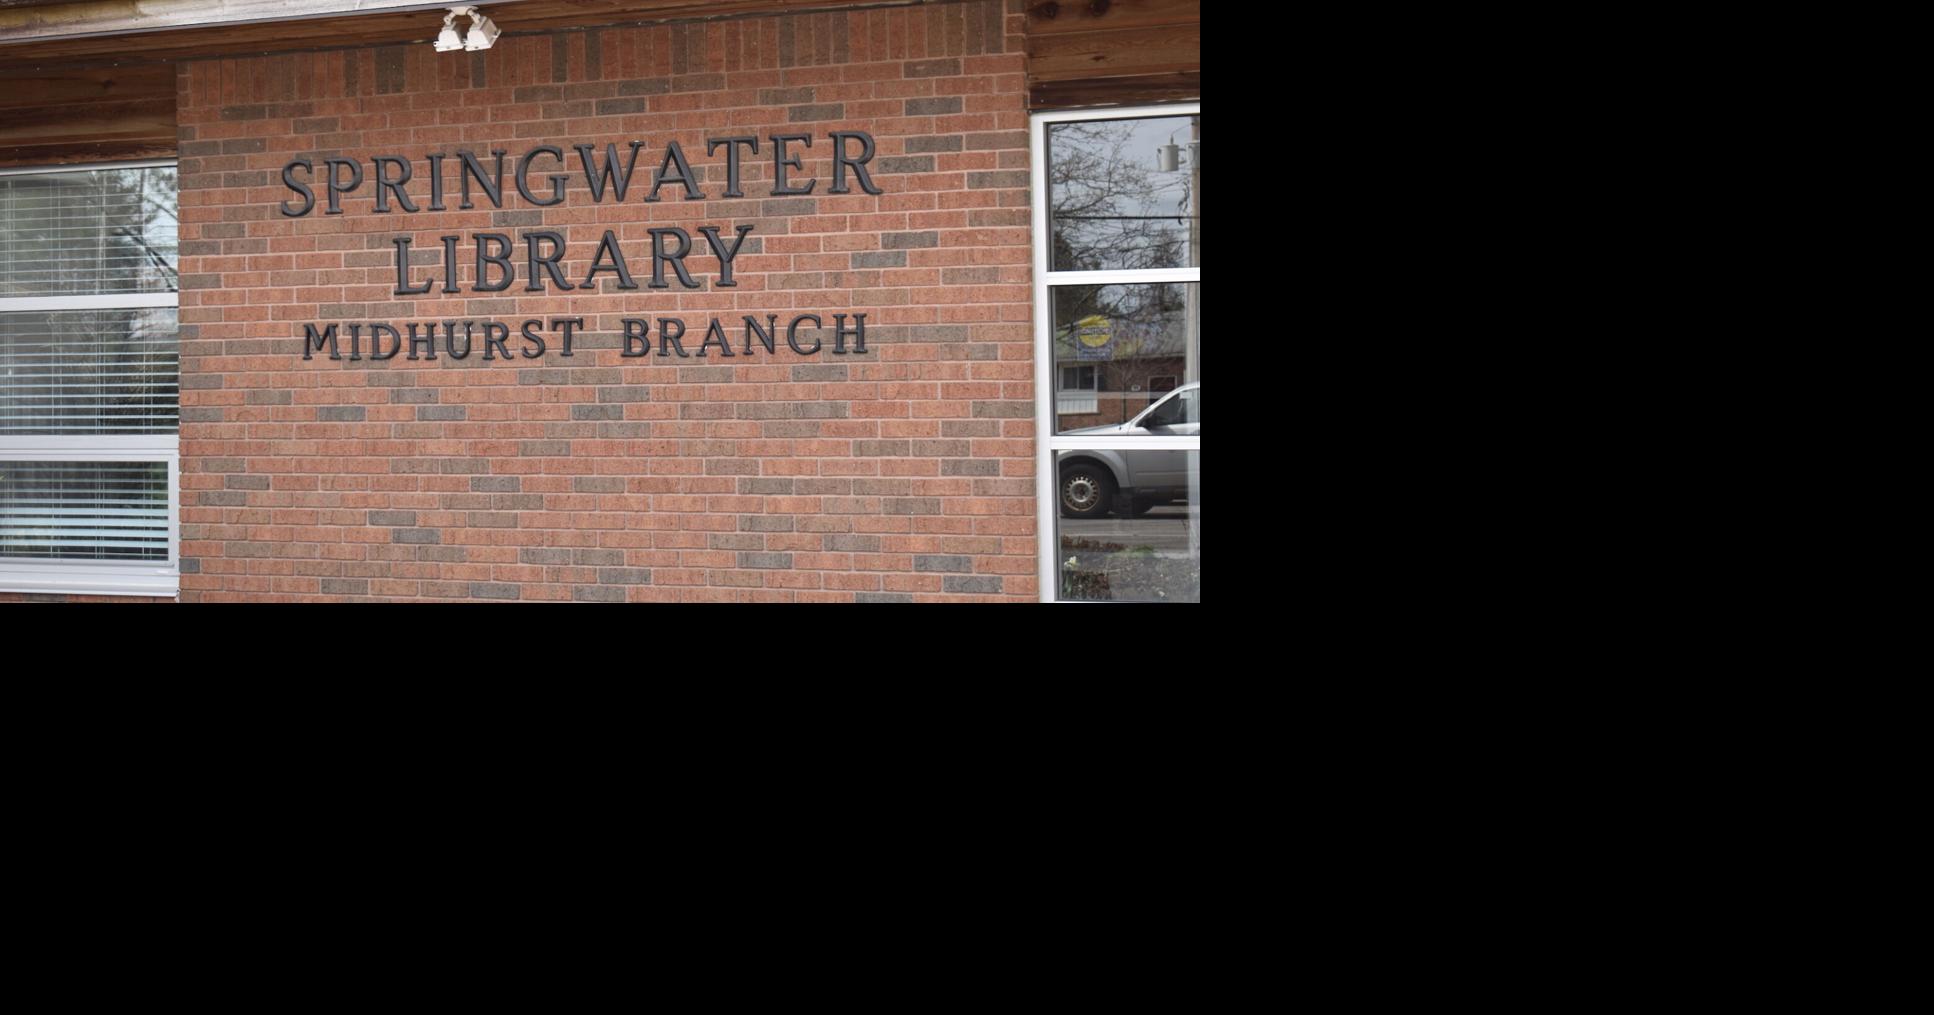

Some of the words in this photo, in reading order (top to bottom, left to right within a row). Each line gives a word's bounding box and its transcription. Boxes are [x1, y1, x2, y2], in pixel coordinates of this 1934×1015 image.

[281, 130, 884, 218] SPRINGWATER
[393, 224, 755, 296] LIBRARY
[302, 316, 584, 361] MIDHURST
[620, 312, 870, 358] BRANCH
